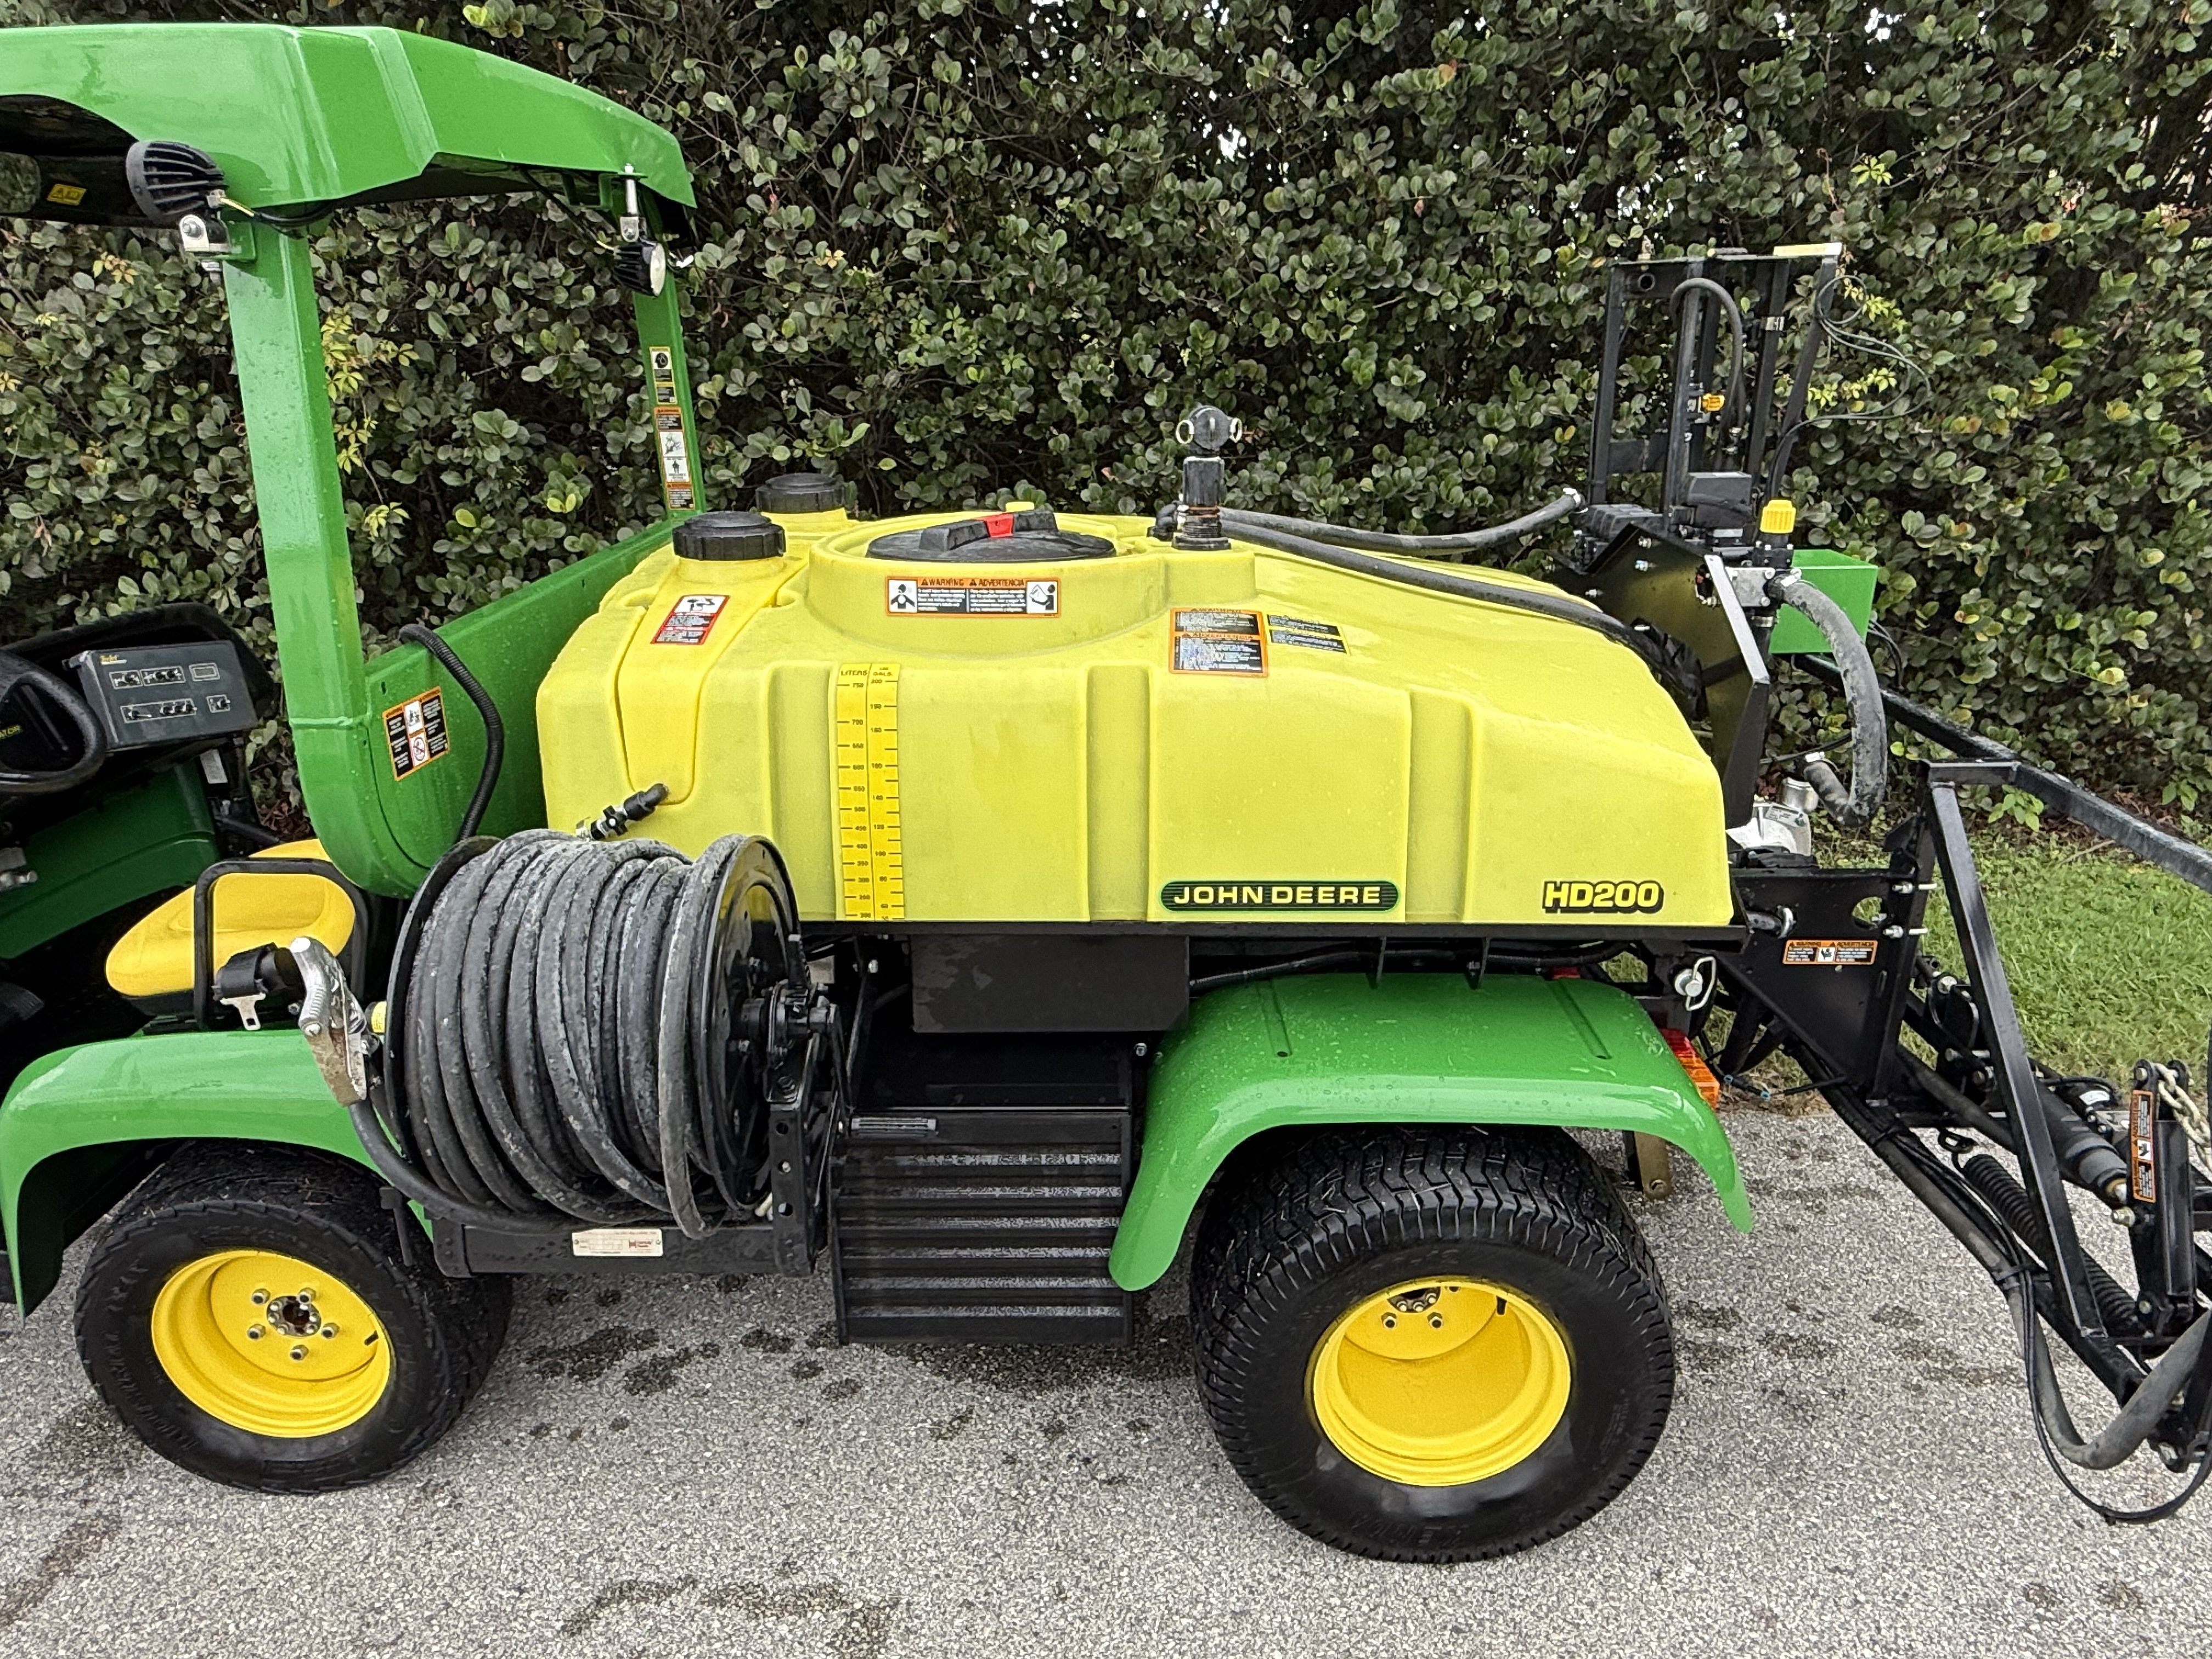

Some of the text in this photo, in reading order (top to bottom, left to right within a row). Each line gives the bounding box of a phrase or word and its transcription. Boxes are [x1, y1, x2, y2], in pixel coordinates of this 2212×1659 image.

[928, 578, 964, 586] WARNING
[1173, 886, 1381, 904] JOHN DEERE
[1543, 881, 1662, 911] HD200
